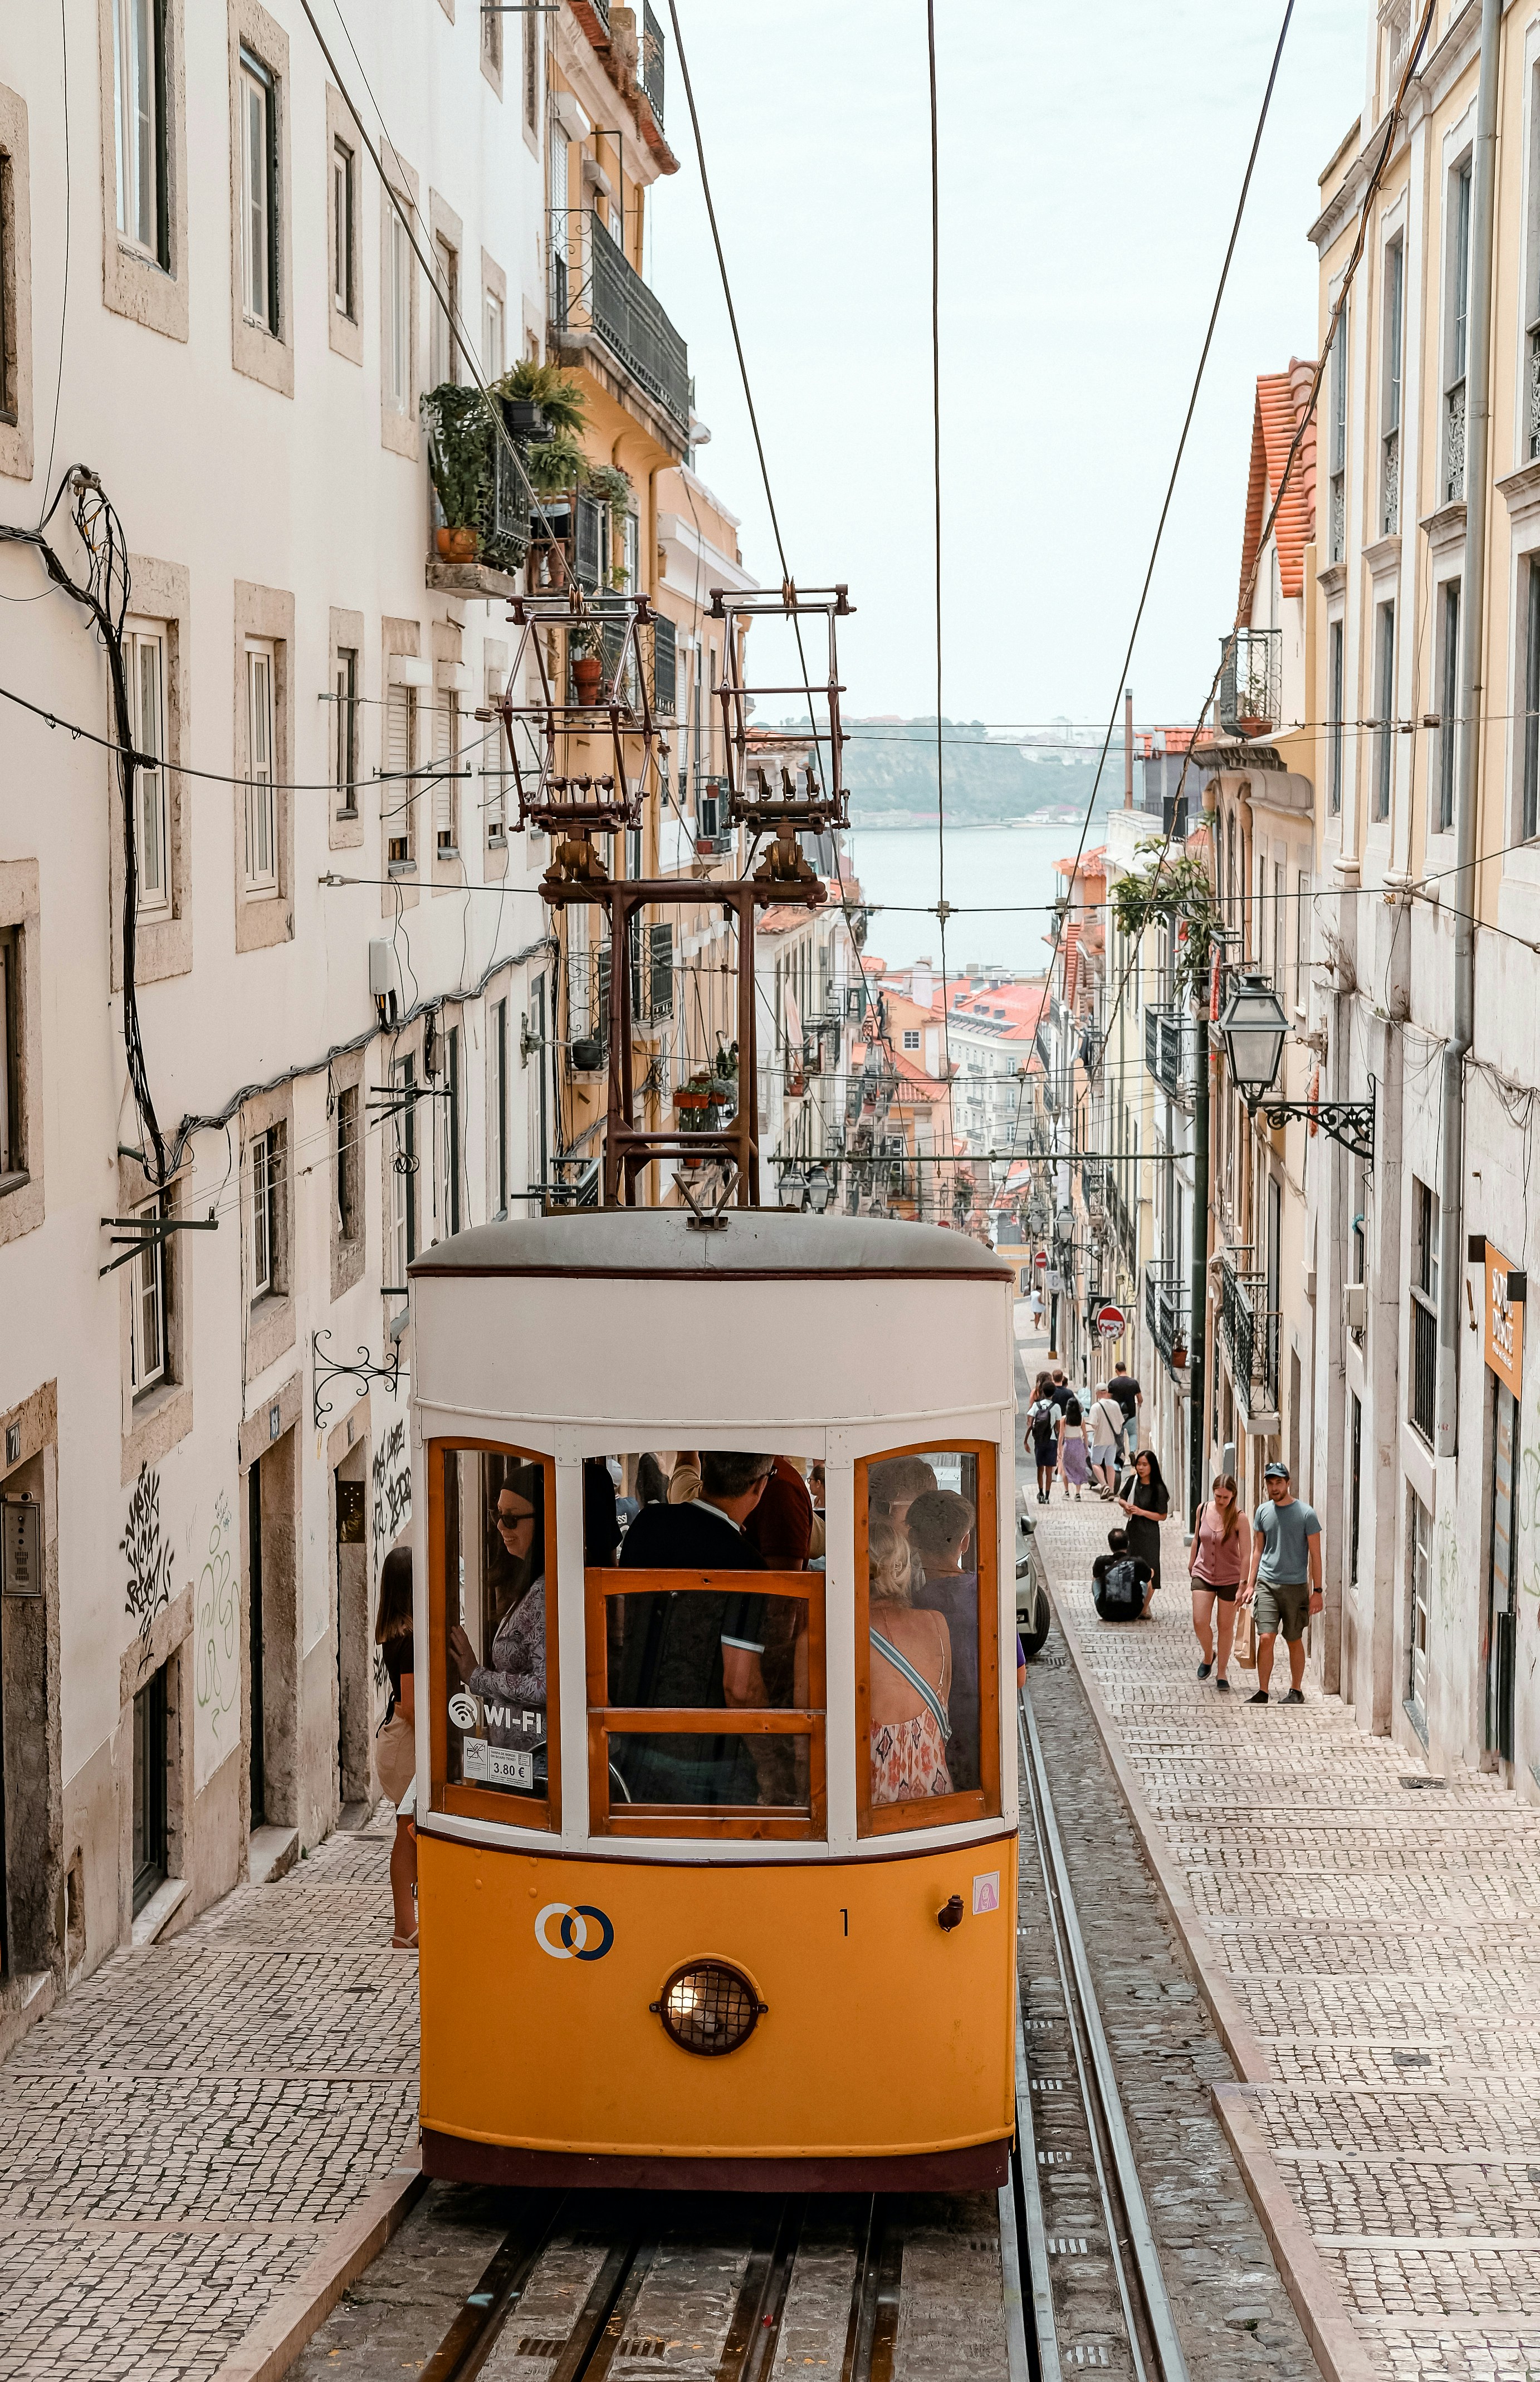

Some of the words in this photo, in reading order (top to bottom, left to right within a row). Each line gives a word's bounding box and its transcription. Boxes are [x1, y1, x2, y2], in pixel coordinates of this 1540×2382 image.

[272, 1411, 278, 1435] 68
[10, 1426, 19, 1460] 70
[483, 1704, 541, 1734] WI-FI
[493, 1762, 515, 1776] 3.80
[518, 1767, 525, 1778] €
[839, 1909, 848, 1937] 1
